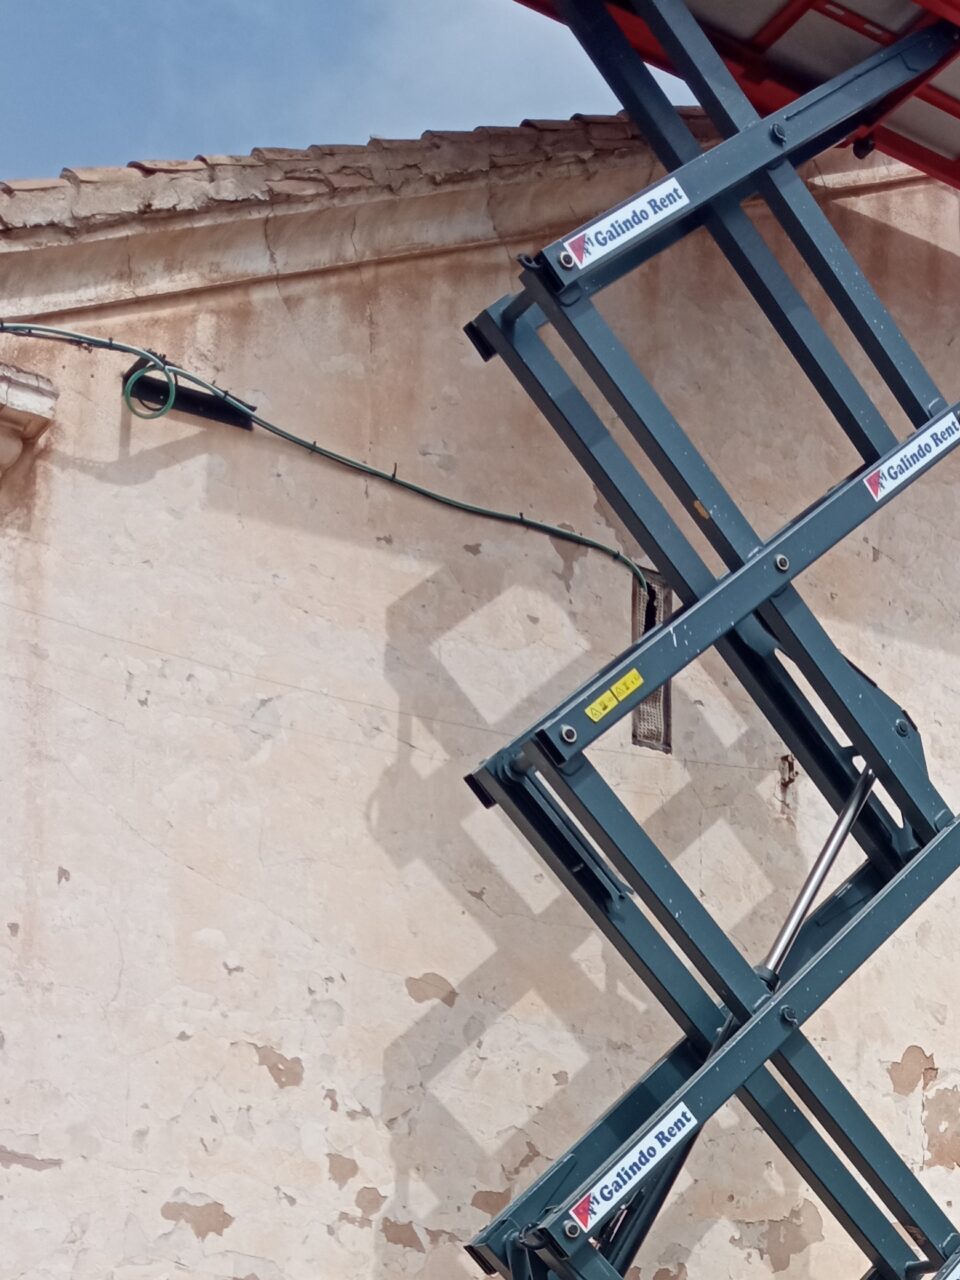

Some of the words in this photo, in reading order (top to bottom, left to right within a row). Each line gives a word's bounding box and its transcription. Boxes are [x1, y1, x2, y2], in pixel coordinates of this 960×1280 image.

[594, 210, 649, 247] Galindo
[647, 187, 683, 216] Rent
[887, 443, 932, 481] Galindo
[930, 420, 960, 447] Rent
[600, 1146, 657, 1201] Galindo
[654, 1110, 692, 1148] Rent
